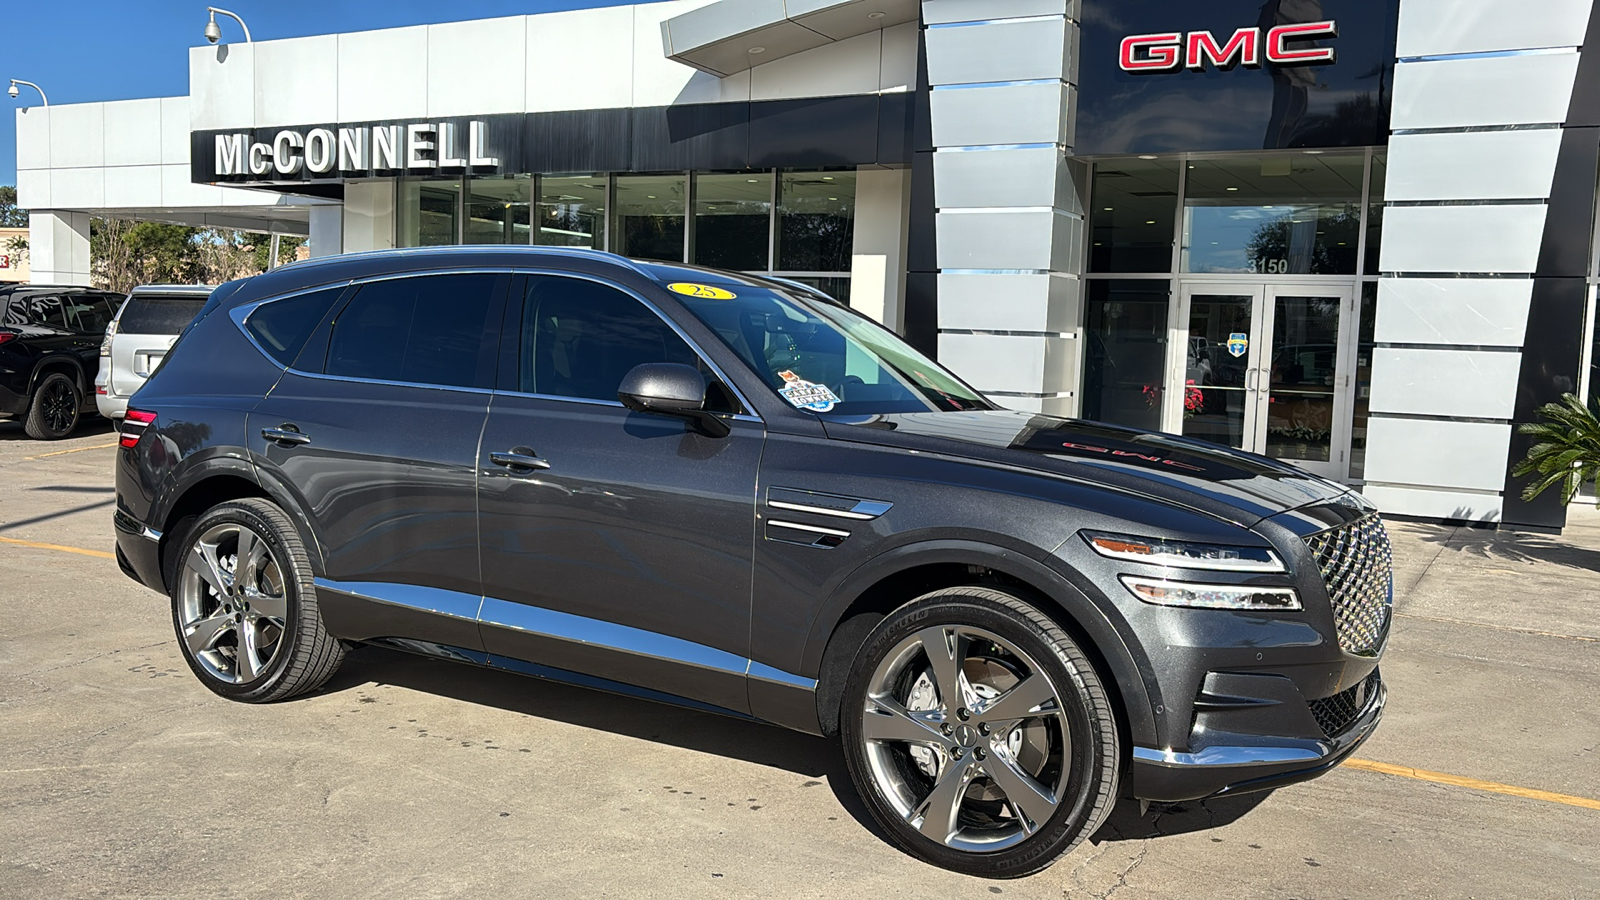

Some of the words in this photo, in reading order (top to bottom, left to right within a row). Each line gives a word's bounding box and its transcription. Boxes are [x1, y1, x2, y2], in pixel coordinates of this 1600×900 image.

[1119, 20, 1339, 71] GMC
[215, 120, 498, 175] McCONNELL
[1247, 257, 1288, 274] 3150
[689, 285, 716, 297] 25
